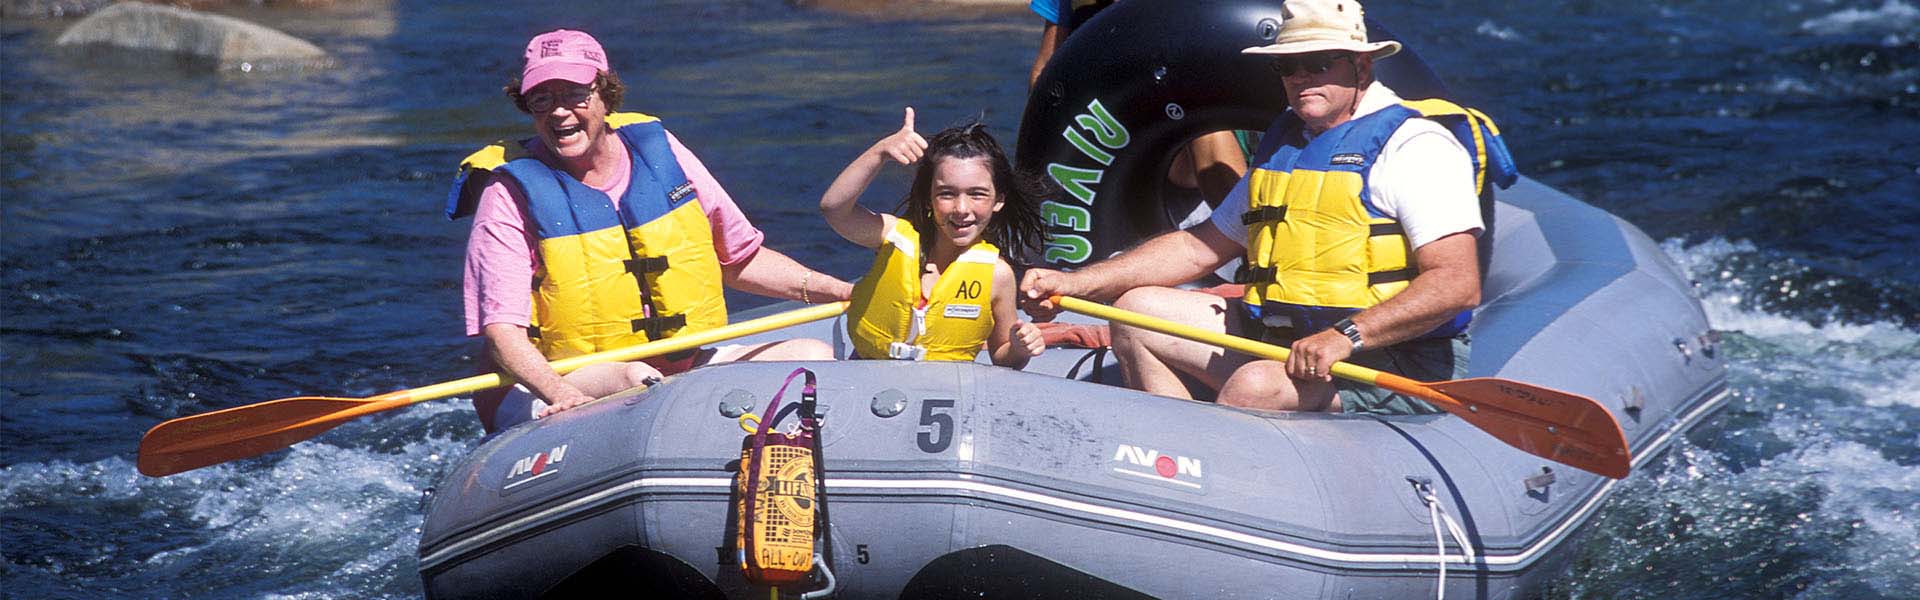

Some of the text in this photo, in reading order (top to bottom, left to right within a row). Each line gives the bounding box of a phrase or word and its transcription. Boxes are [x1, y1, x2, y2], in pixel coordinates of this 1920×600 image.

[1040, 98, 1130, 263] RIVER
[955, 280, 981, 299] AO
[917, 399, 954, 453] 5
[507, 444, 568, 479] AVON
[1113, 444, 1202, 478] AVON
[857, 544, 870, 565] 5
